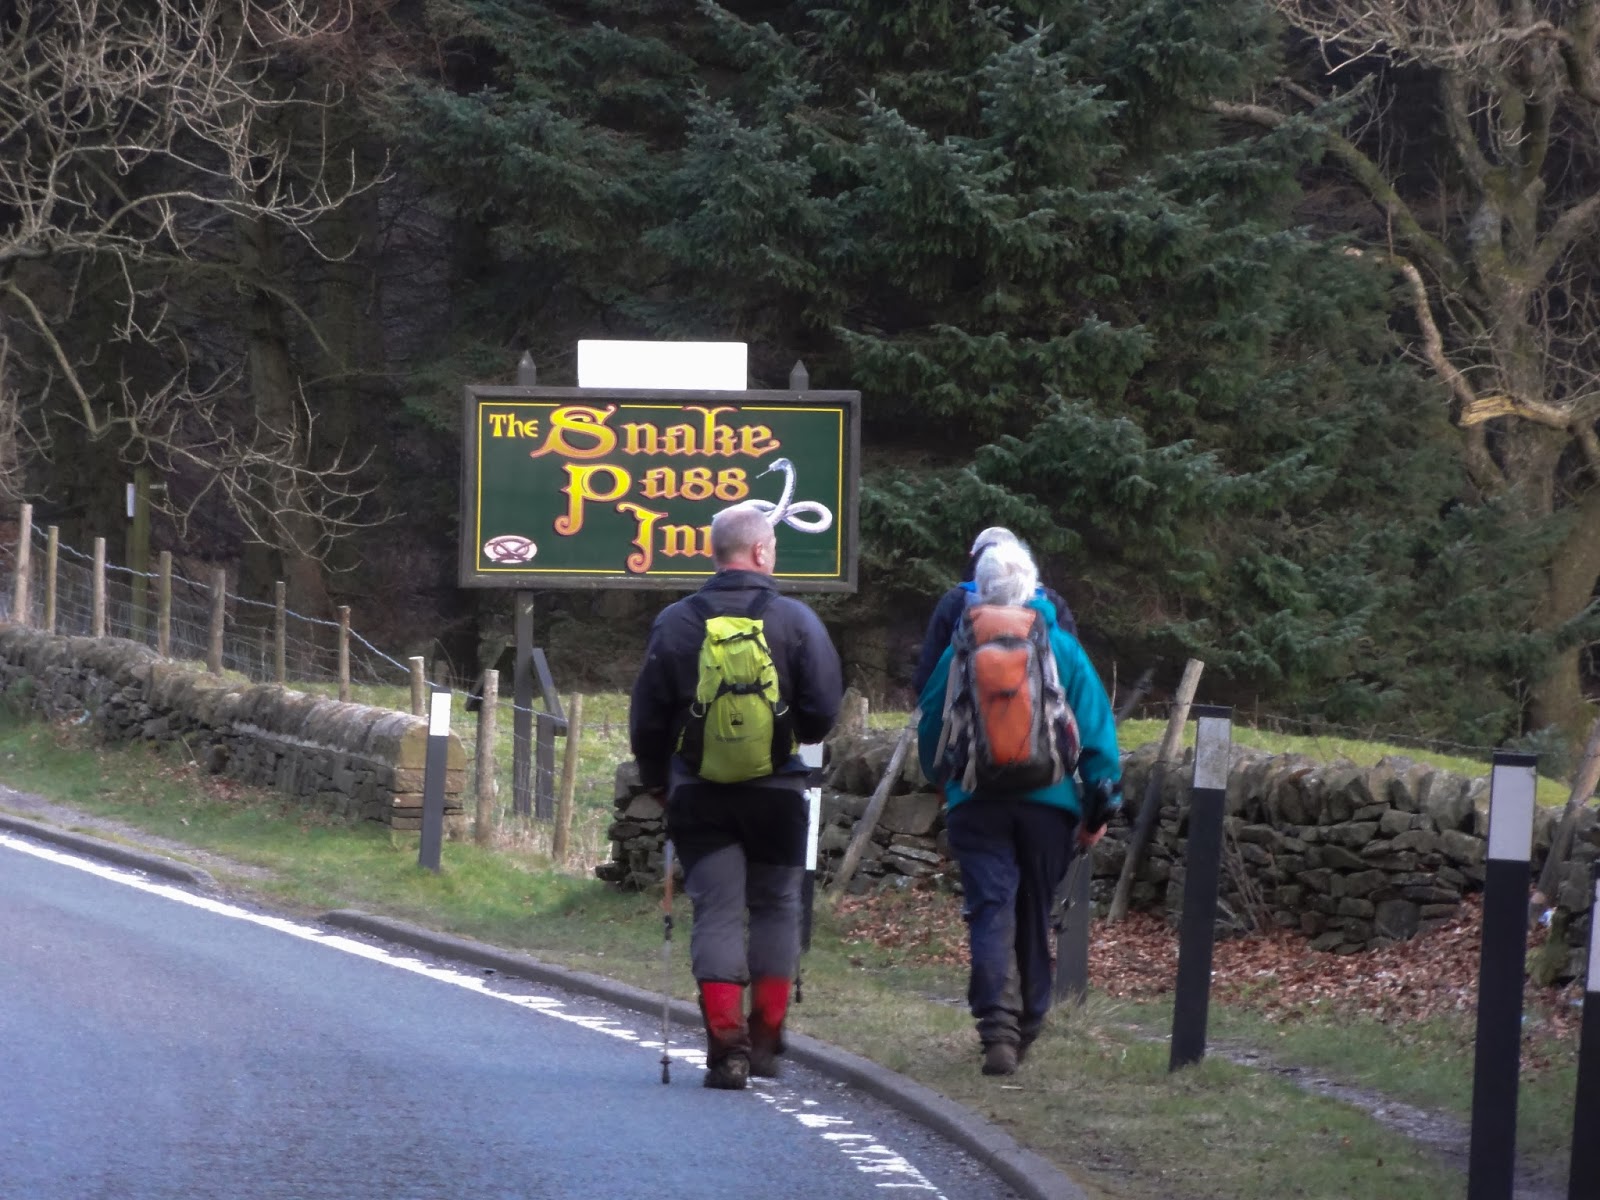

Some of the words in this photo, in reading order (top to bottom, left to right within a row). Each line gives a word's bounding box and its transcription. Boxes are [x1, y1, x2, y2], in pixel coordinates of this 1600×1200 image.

[489, 413, 539, 438] The
[530, 404, 781, 459] Snake
[554, 462, 749, 536] Pass
